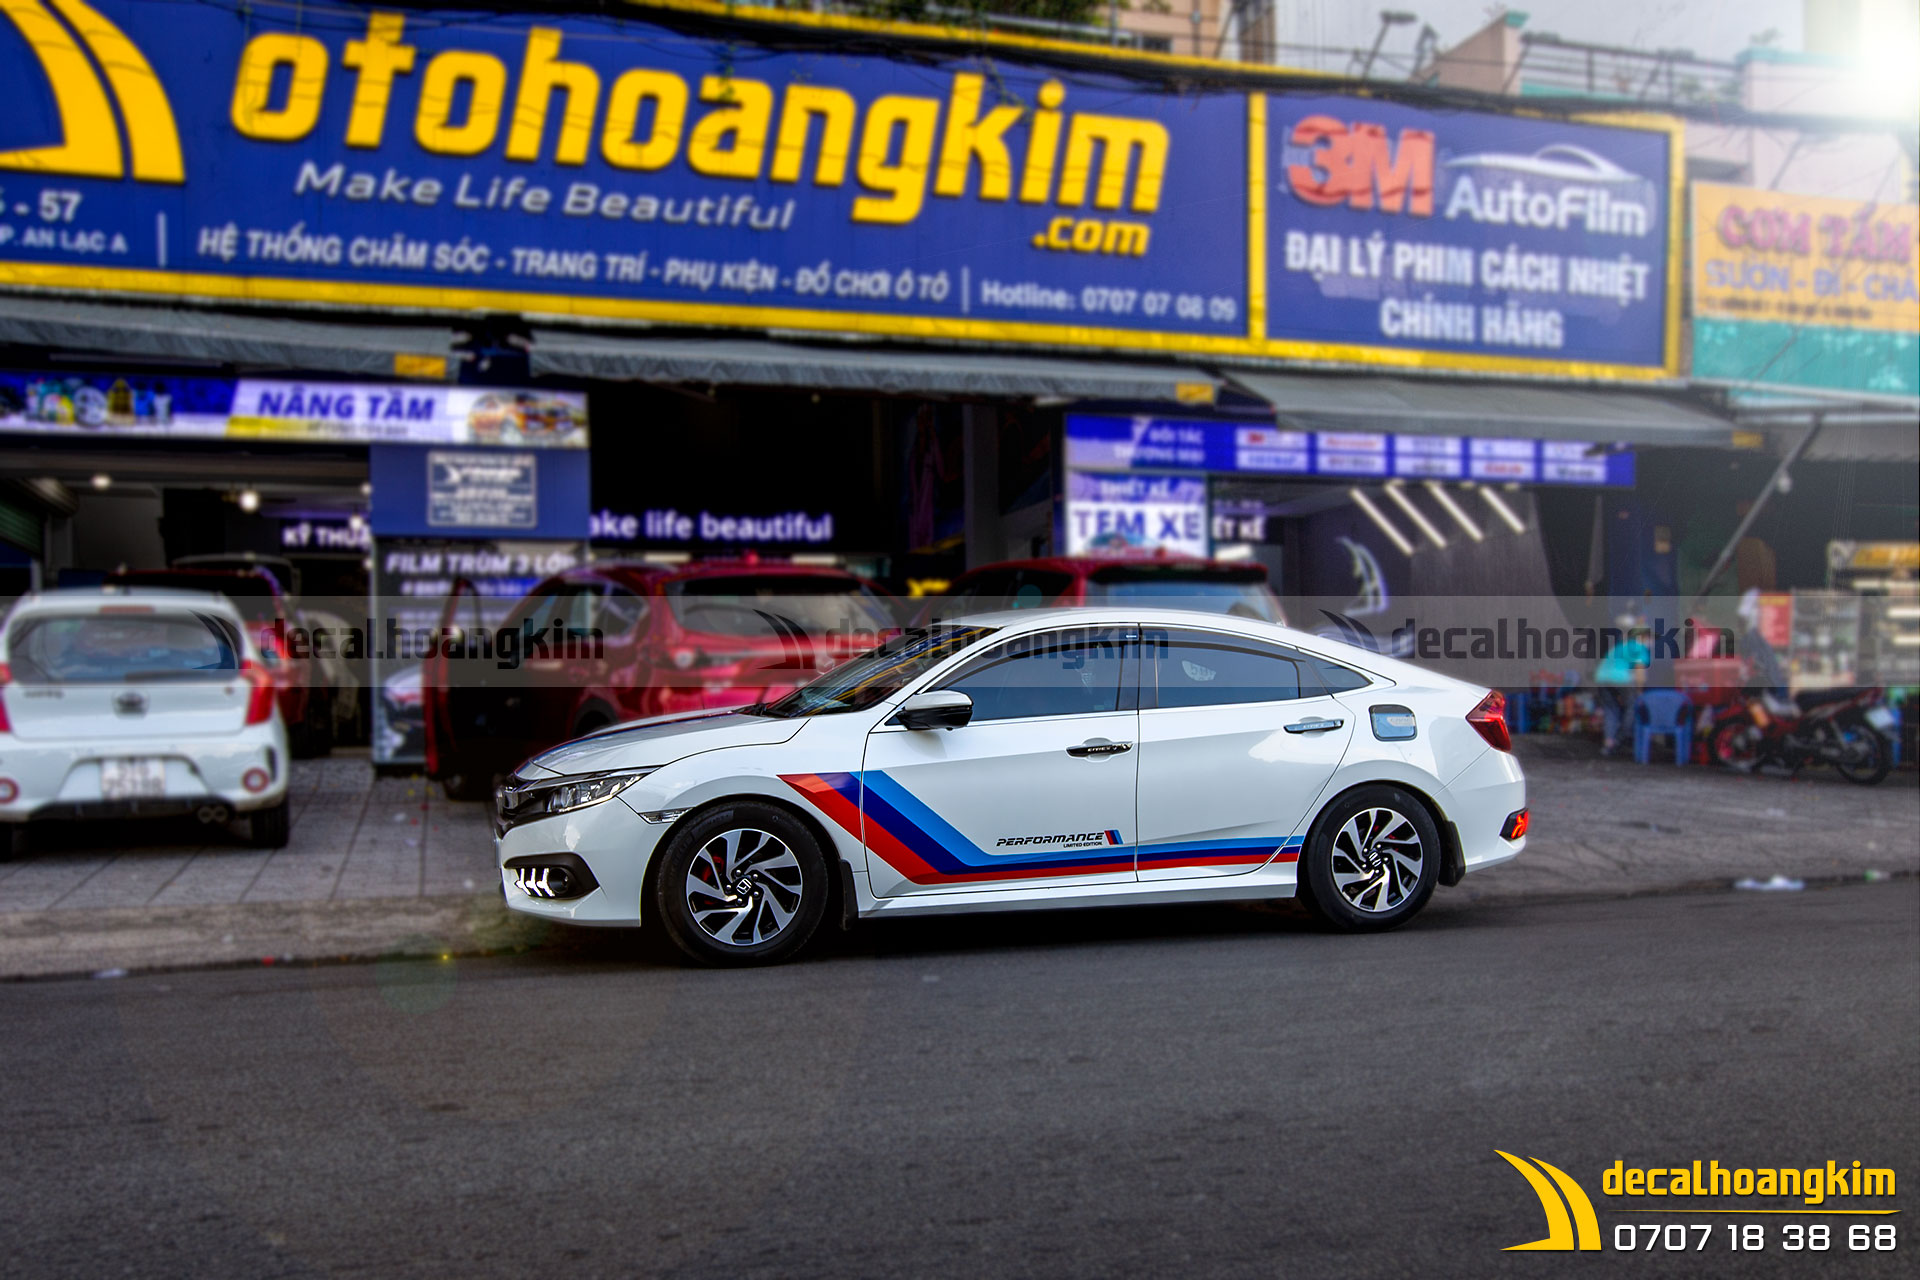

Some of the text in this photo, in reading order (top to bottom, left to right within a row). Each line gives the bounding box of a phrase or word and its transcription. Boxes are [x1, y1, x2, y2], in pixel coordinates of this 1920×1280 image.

[231, 12, 1170, 225] otohoangkim
[1286, 115, 1435, 217] 3M
[39, 190, 82, 222] 57
[294, 161, 796, 230] Make Life Beautiful
[1444, 175, 1647, 237] AutoFilm
[22, 226, 54, 248] AN
[60, 229, 107, 255] LẠC
[111, 231, 128, 254] A
[1032, 216, 1151, 256] .com
[198, 221, 238, 263] HỆ
[246, 221, 342, 265] THỐNG
[349, 233, 428, 268] CHĂM
[432, 236, 490, 273] SÓC
[511, 248, 598, 280] TRANG
[604, 250, 648, 283] TRÍ
[663, 257, 716, 291] PHỤ
[719, 258, 778, 294] KIỆN
[834, 268, 890, 298] CHƠI
[919, 272, 950, 301] TÔ
[1284, 230, 1649, 307] ĐẠI LÝ PHIM CÁCH NHIỆT
[981, 279, 1238, 322] Hotline: 0707 07 08 09
[1379, 293, 1564, 349] CHÍNH HÃNG
[645, 509, 694, 540] life
[700, 511, 833, 541] beautiful
[1157, 510, 1201, 541] XE
[385, 552, 442, 575] FILM
[515, 553, 531, 574] 3
[996, 831, 1105, 847] PERFORMANCE
